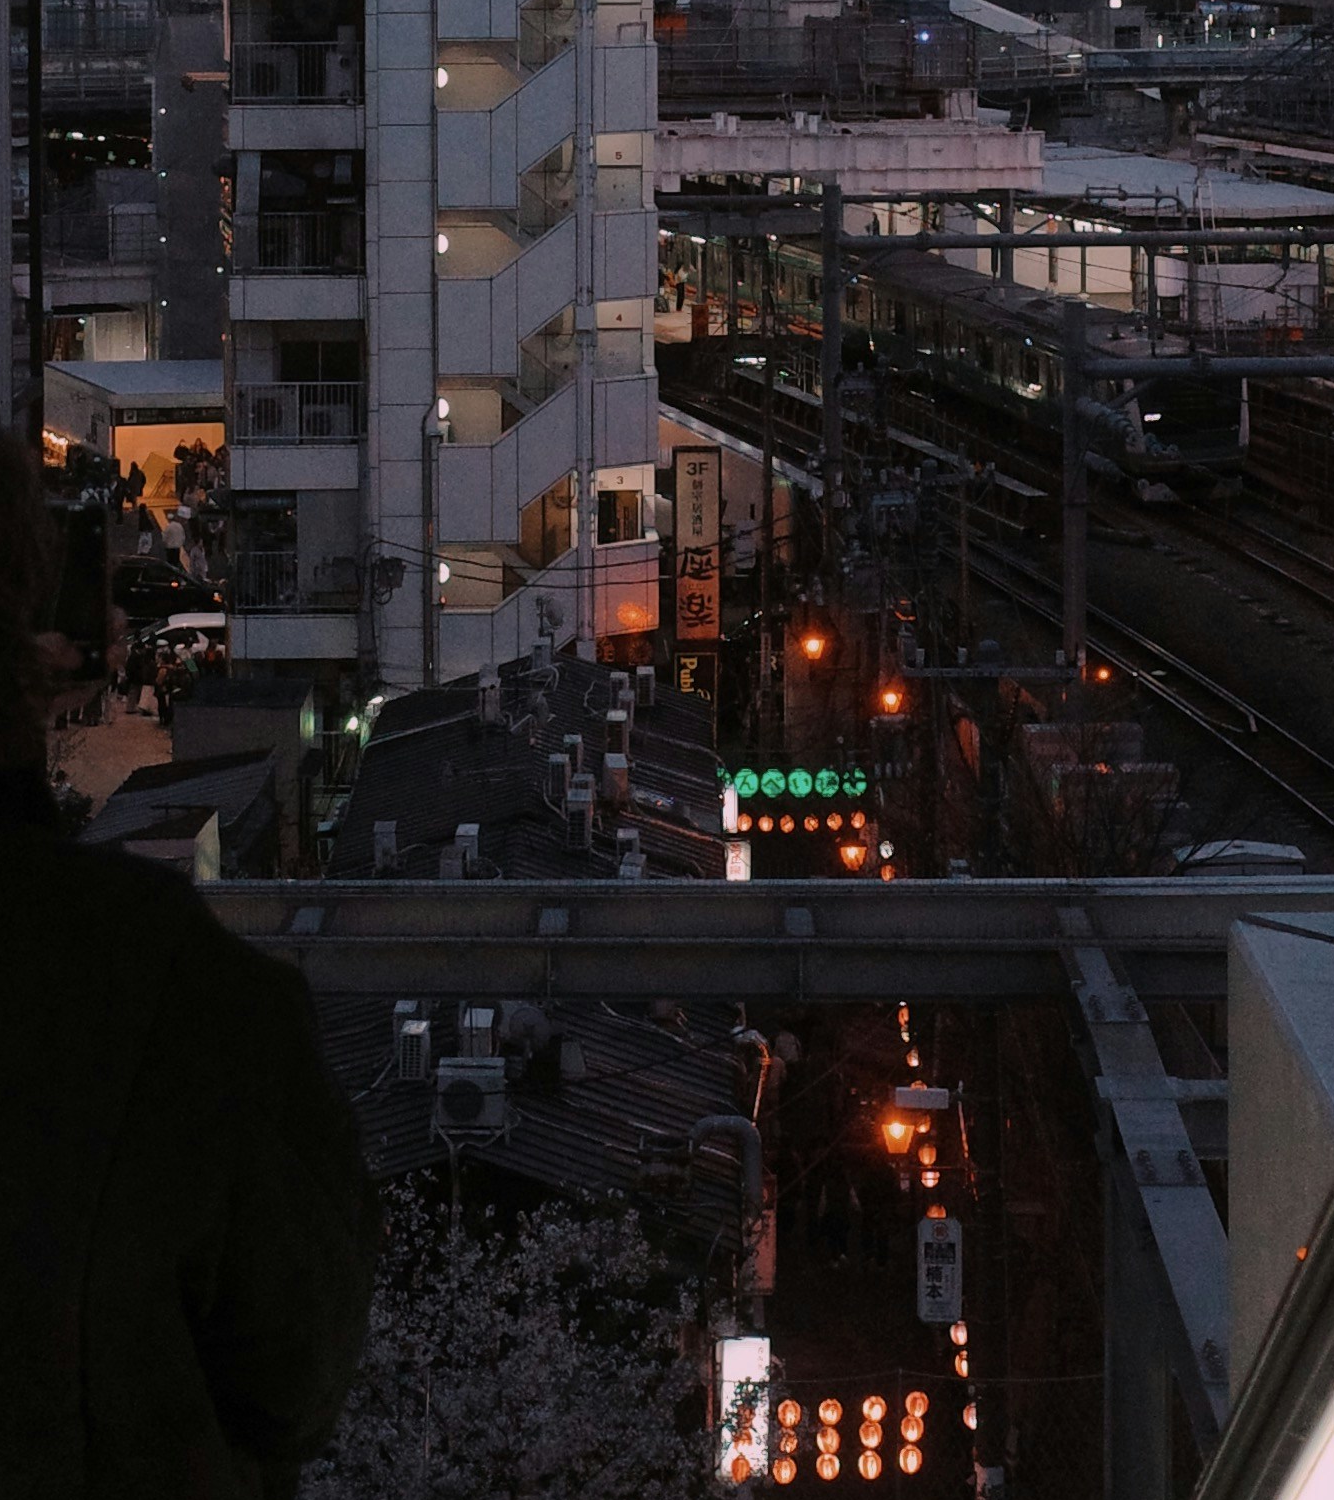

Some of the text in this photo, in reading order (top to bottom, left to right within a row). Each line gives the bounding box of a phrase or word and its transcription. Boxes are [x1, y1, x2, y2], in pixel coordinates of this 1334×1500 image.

[615, 151, 622, 160] 5
[615, 313, 623, 322] 4
[686, 462, 709, 476] 3F
[616, 476, 624, 485] 3
